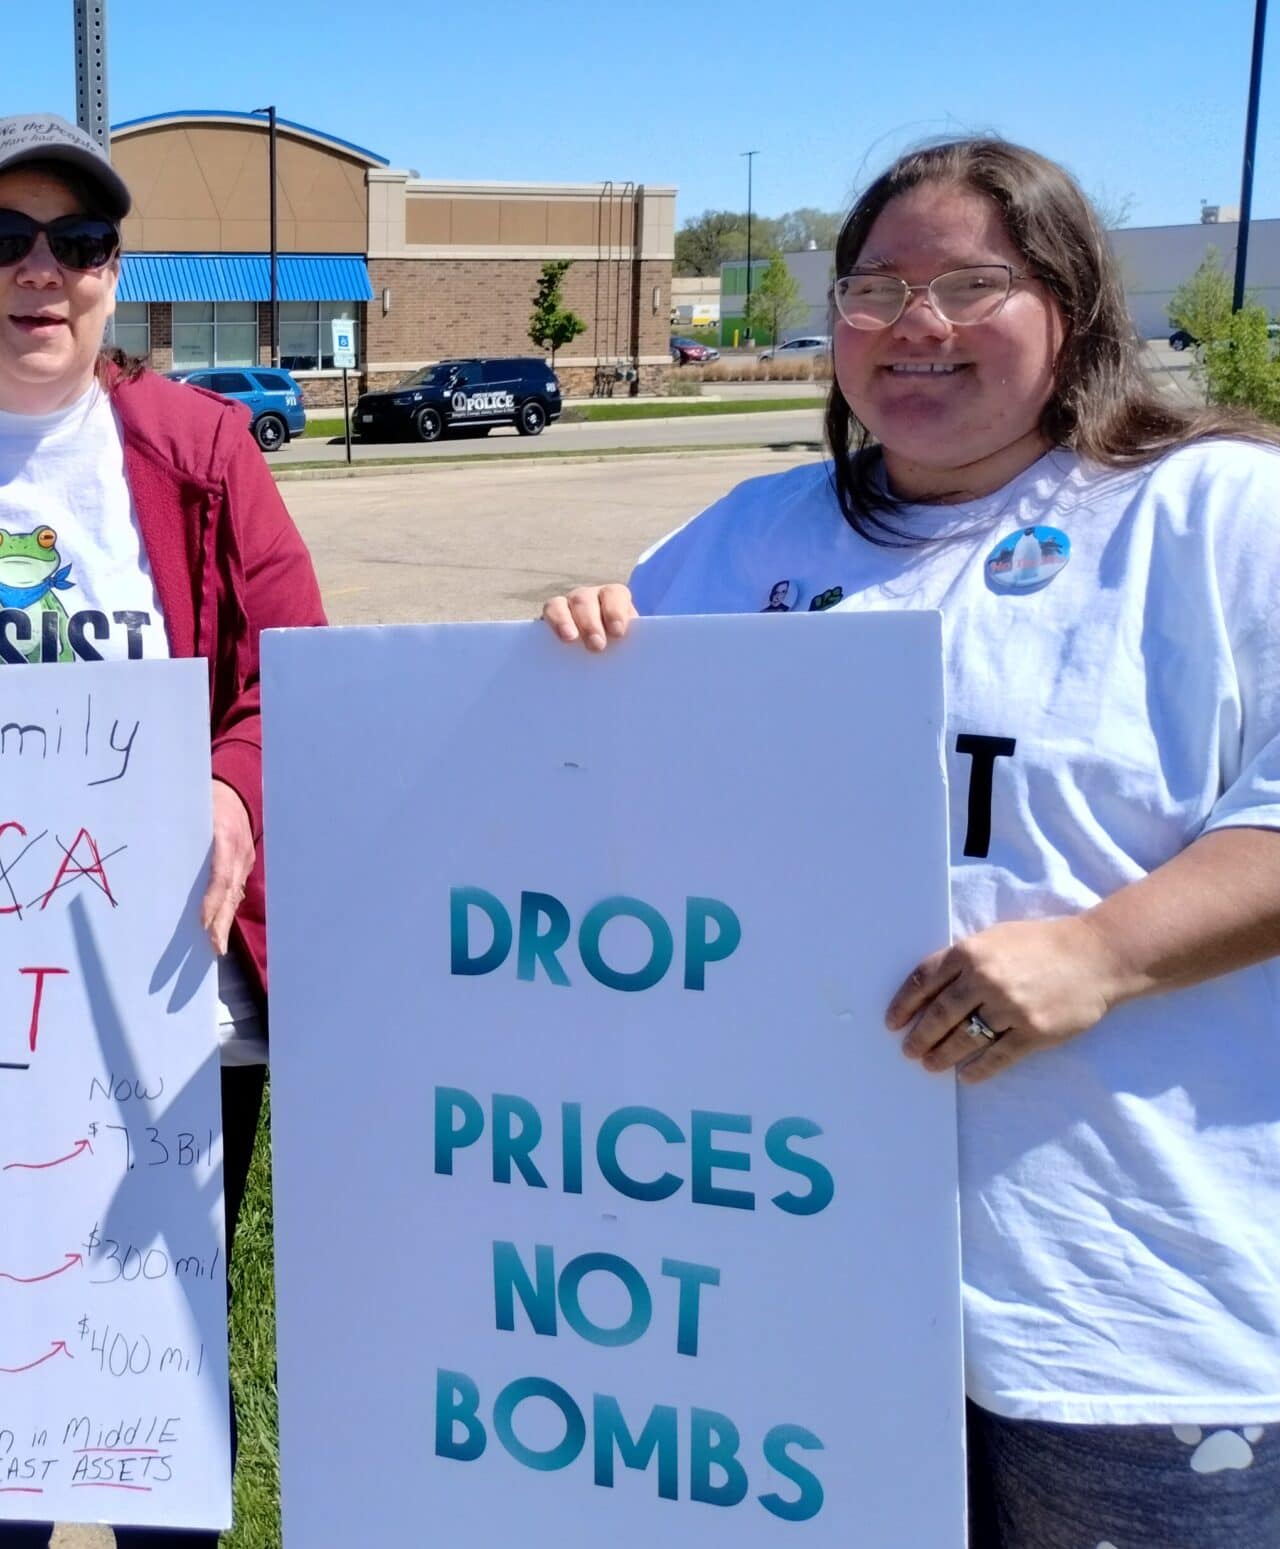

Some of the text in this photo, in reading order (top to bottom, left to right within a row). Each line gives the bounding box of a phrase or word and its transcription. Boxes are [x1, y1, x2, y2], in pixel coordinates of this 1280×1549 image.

[467, 394, 515, 411] POLICE
[449, 884, 742, 993] DROP
[177, 1129, 213, 1166] Bil
[433, 1085, 835, 1217] PRICES
[81, 1221, 169, 1285] $300
[492, 1239, 721, 1358] NOT
[77, 1312, 152, 1377] $400
[31, 1430, 48, 1446] in
[71, 1454, 174, 1482] ASSETS
[434, 1366, 826, 1523] BOMBS
